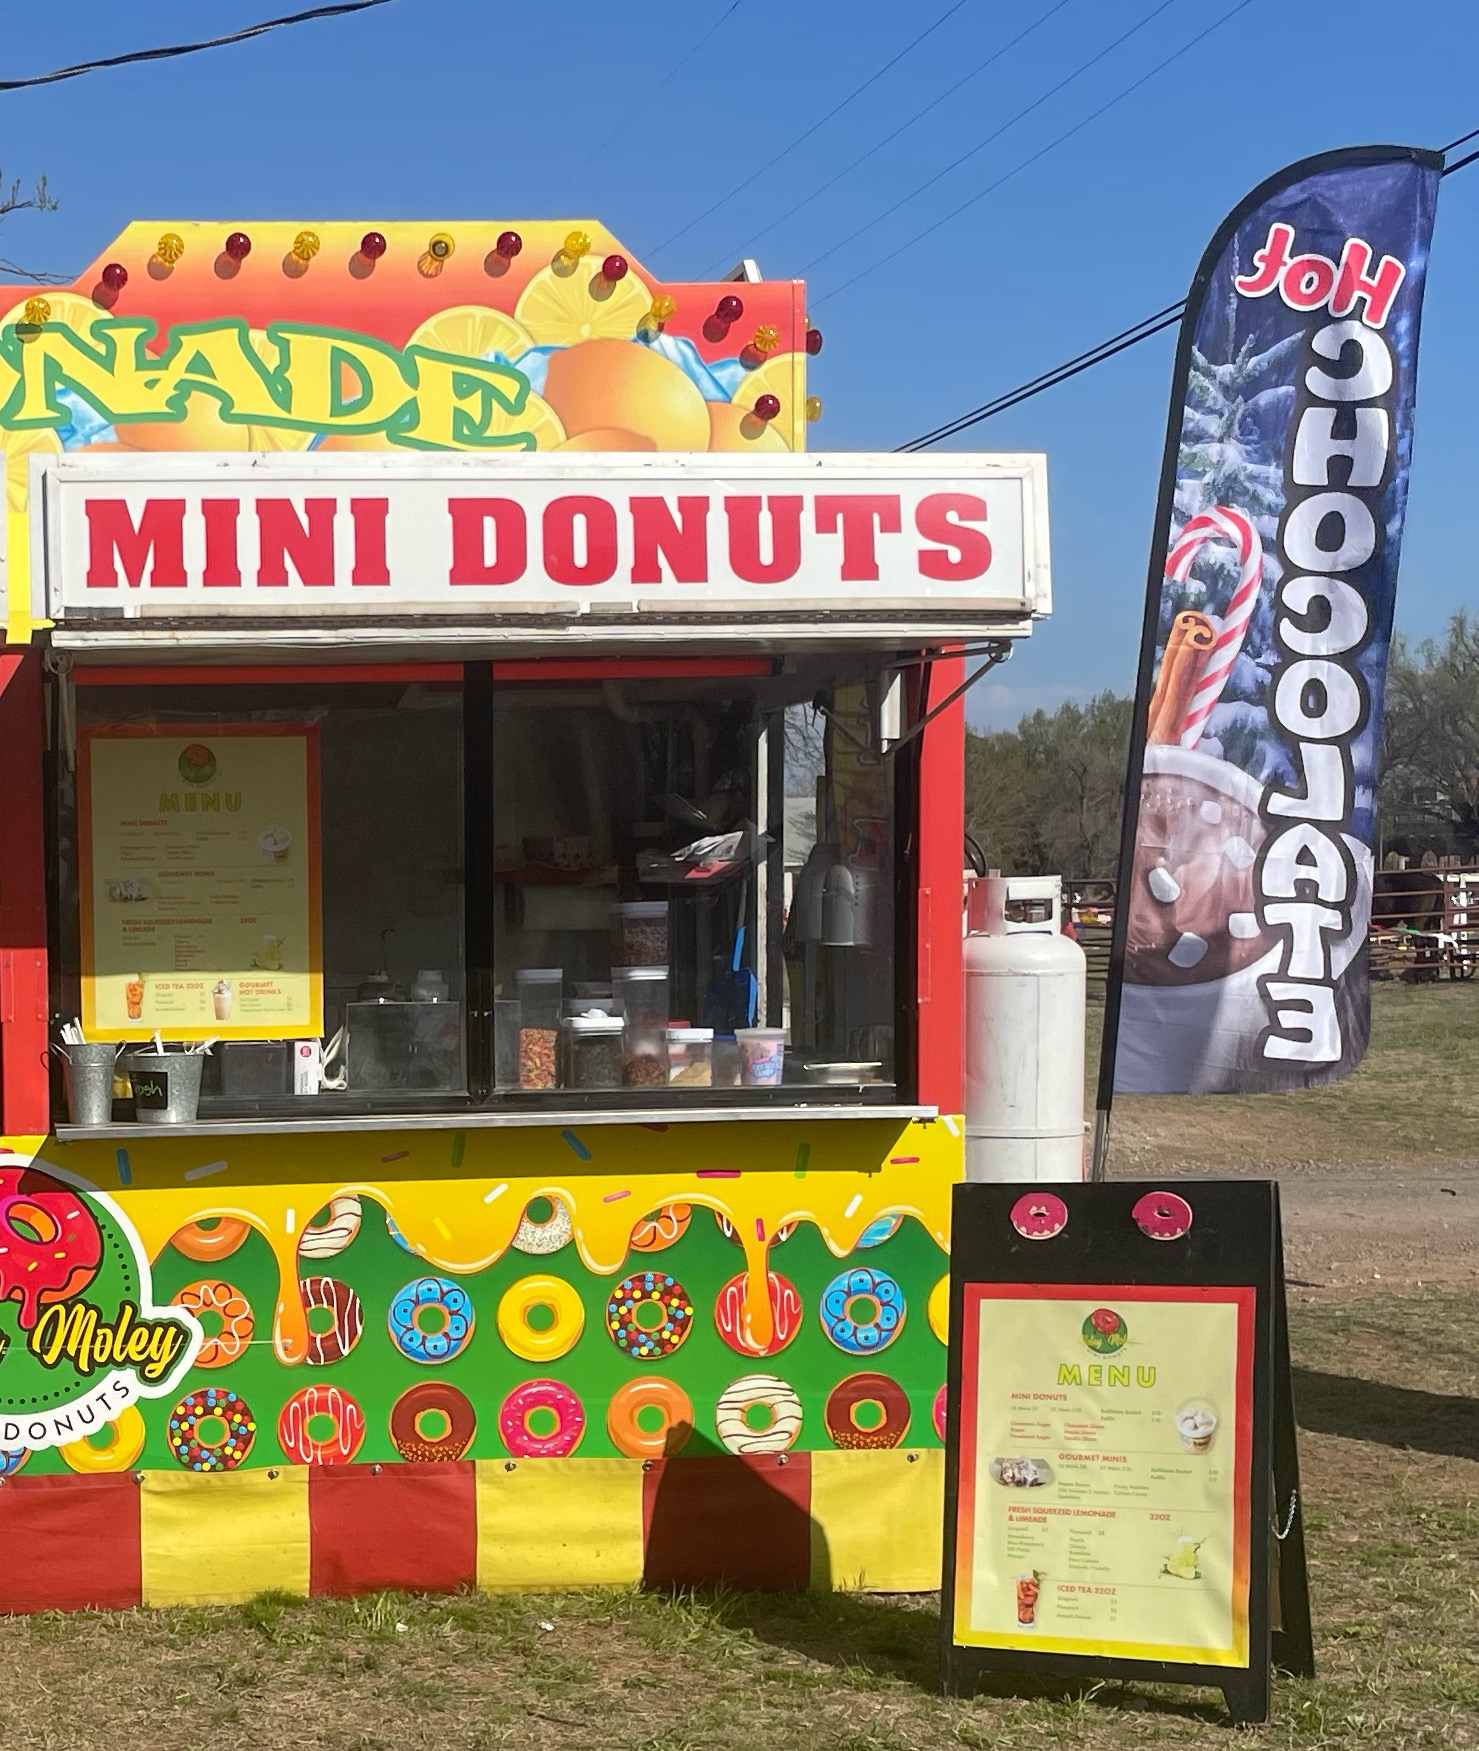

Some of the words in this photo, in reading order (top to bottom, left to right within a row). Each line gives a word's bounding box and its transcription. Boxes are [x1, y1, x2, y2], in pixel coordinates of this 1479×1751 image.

[83, 496, 392, 588] MINI
[446, 494, 993, 586] DONUTS
[158, 792, 243, 813] MENU
[31, 1302, 185, 1380] Moley
[1056, 1362, 1157, 1389] MENU
[1010, 1392, 1031, 1401] MINI
[1032, 1393, 1068, 1402] DONUTS
[4, 1379, 131, 1441] DONUTS
[1058, 1453, 1100, 1463] GOURMET
[1101, 1455, 1128, 1464] MINIS
[1008, 1506, 1032, 1514] FRESH
[1032, 1507, 1072, 1517] SQUEEZED
[1072, 1510, 1116, 1519] LEMONADE
[1057, 1584, 1076, 1593] ICED
[1077, 1585, 1093, 1594] TEA
